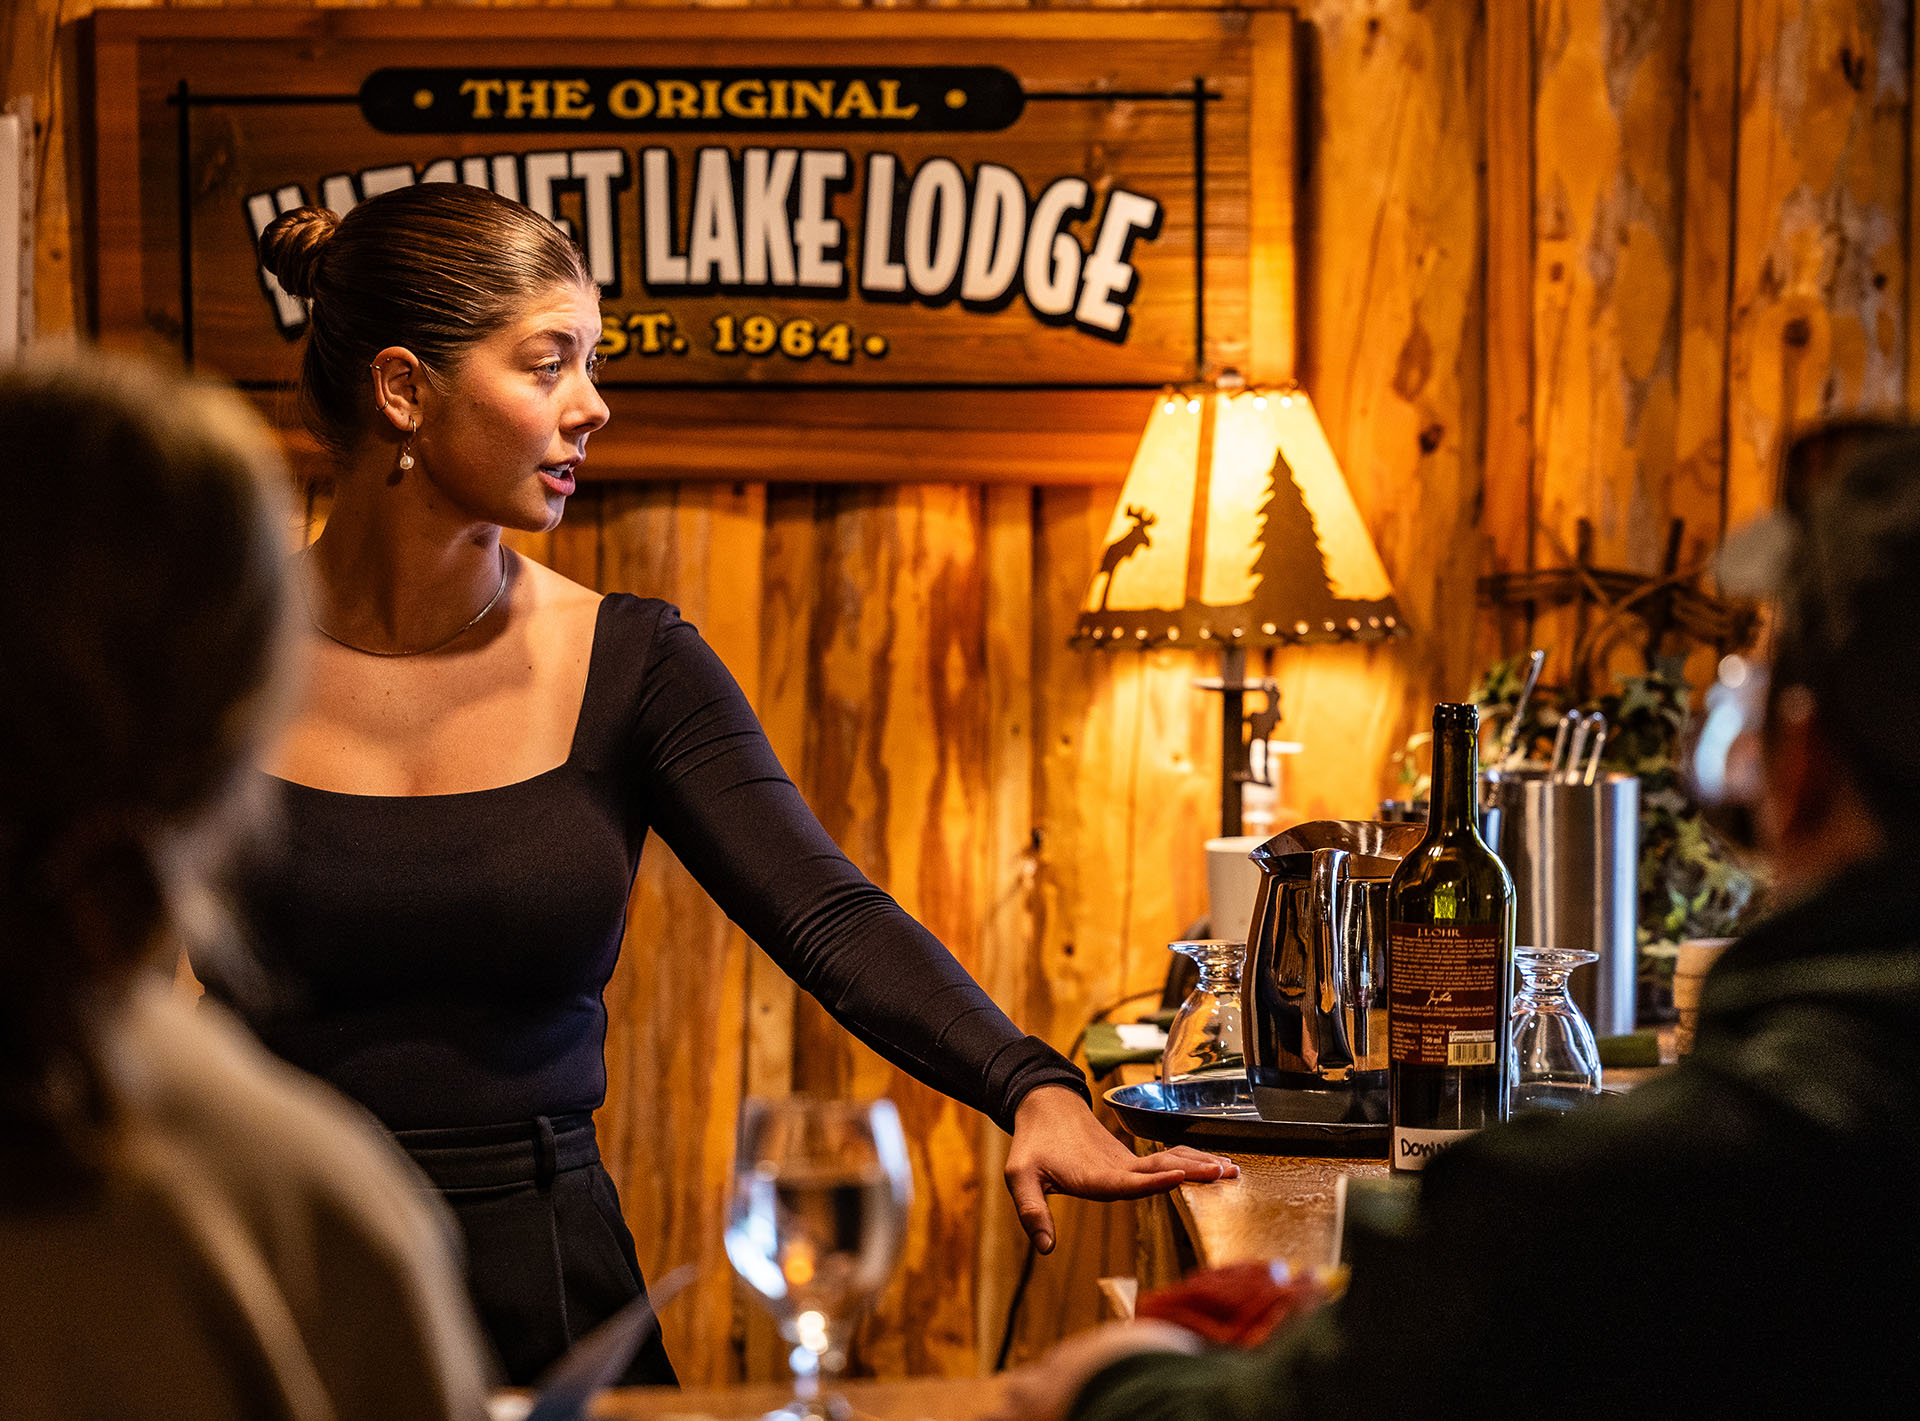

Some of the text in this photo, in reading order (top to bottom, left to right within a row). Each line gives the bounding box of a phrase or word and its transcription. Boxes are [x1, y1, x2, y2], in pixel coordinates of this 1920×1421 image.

[459, 79, 921, 120] THE ORIGINAL
[643, 147, 848, 289] LAKE
[861, 152, 1159, 333] LODGE
[596, 312, 854, 362] ST. 1964
